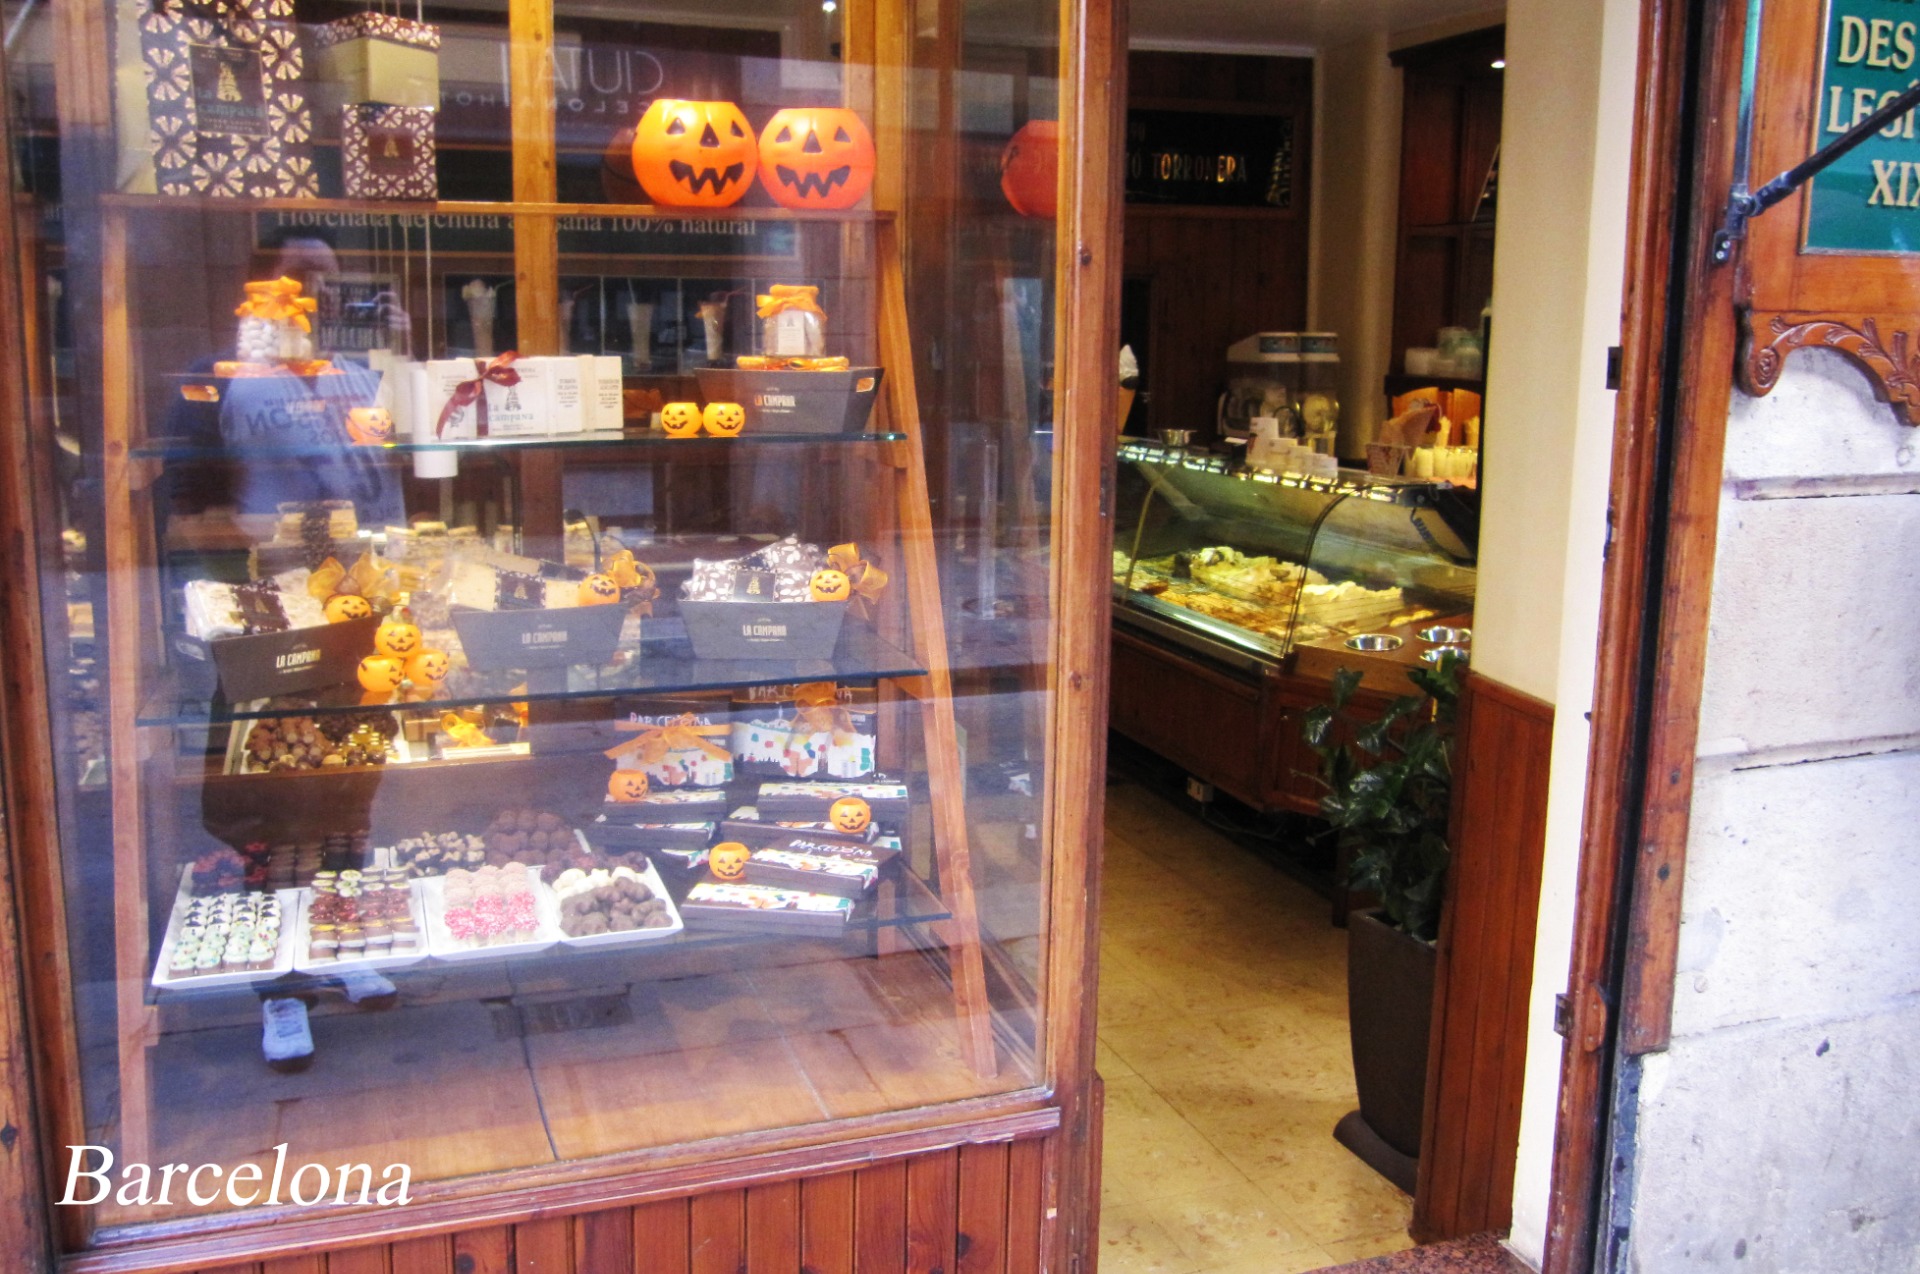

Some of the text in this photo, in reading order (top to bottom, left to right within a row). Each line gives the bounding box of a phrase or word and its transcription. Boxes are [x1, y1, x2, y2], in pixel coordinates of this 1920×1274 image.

[277, 209, 391, 228] Horchata
[610, 214, 674, 235] 100%
[681, 217, 756, 236] natural
[753, 624, 788, 637] CAMPANA
